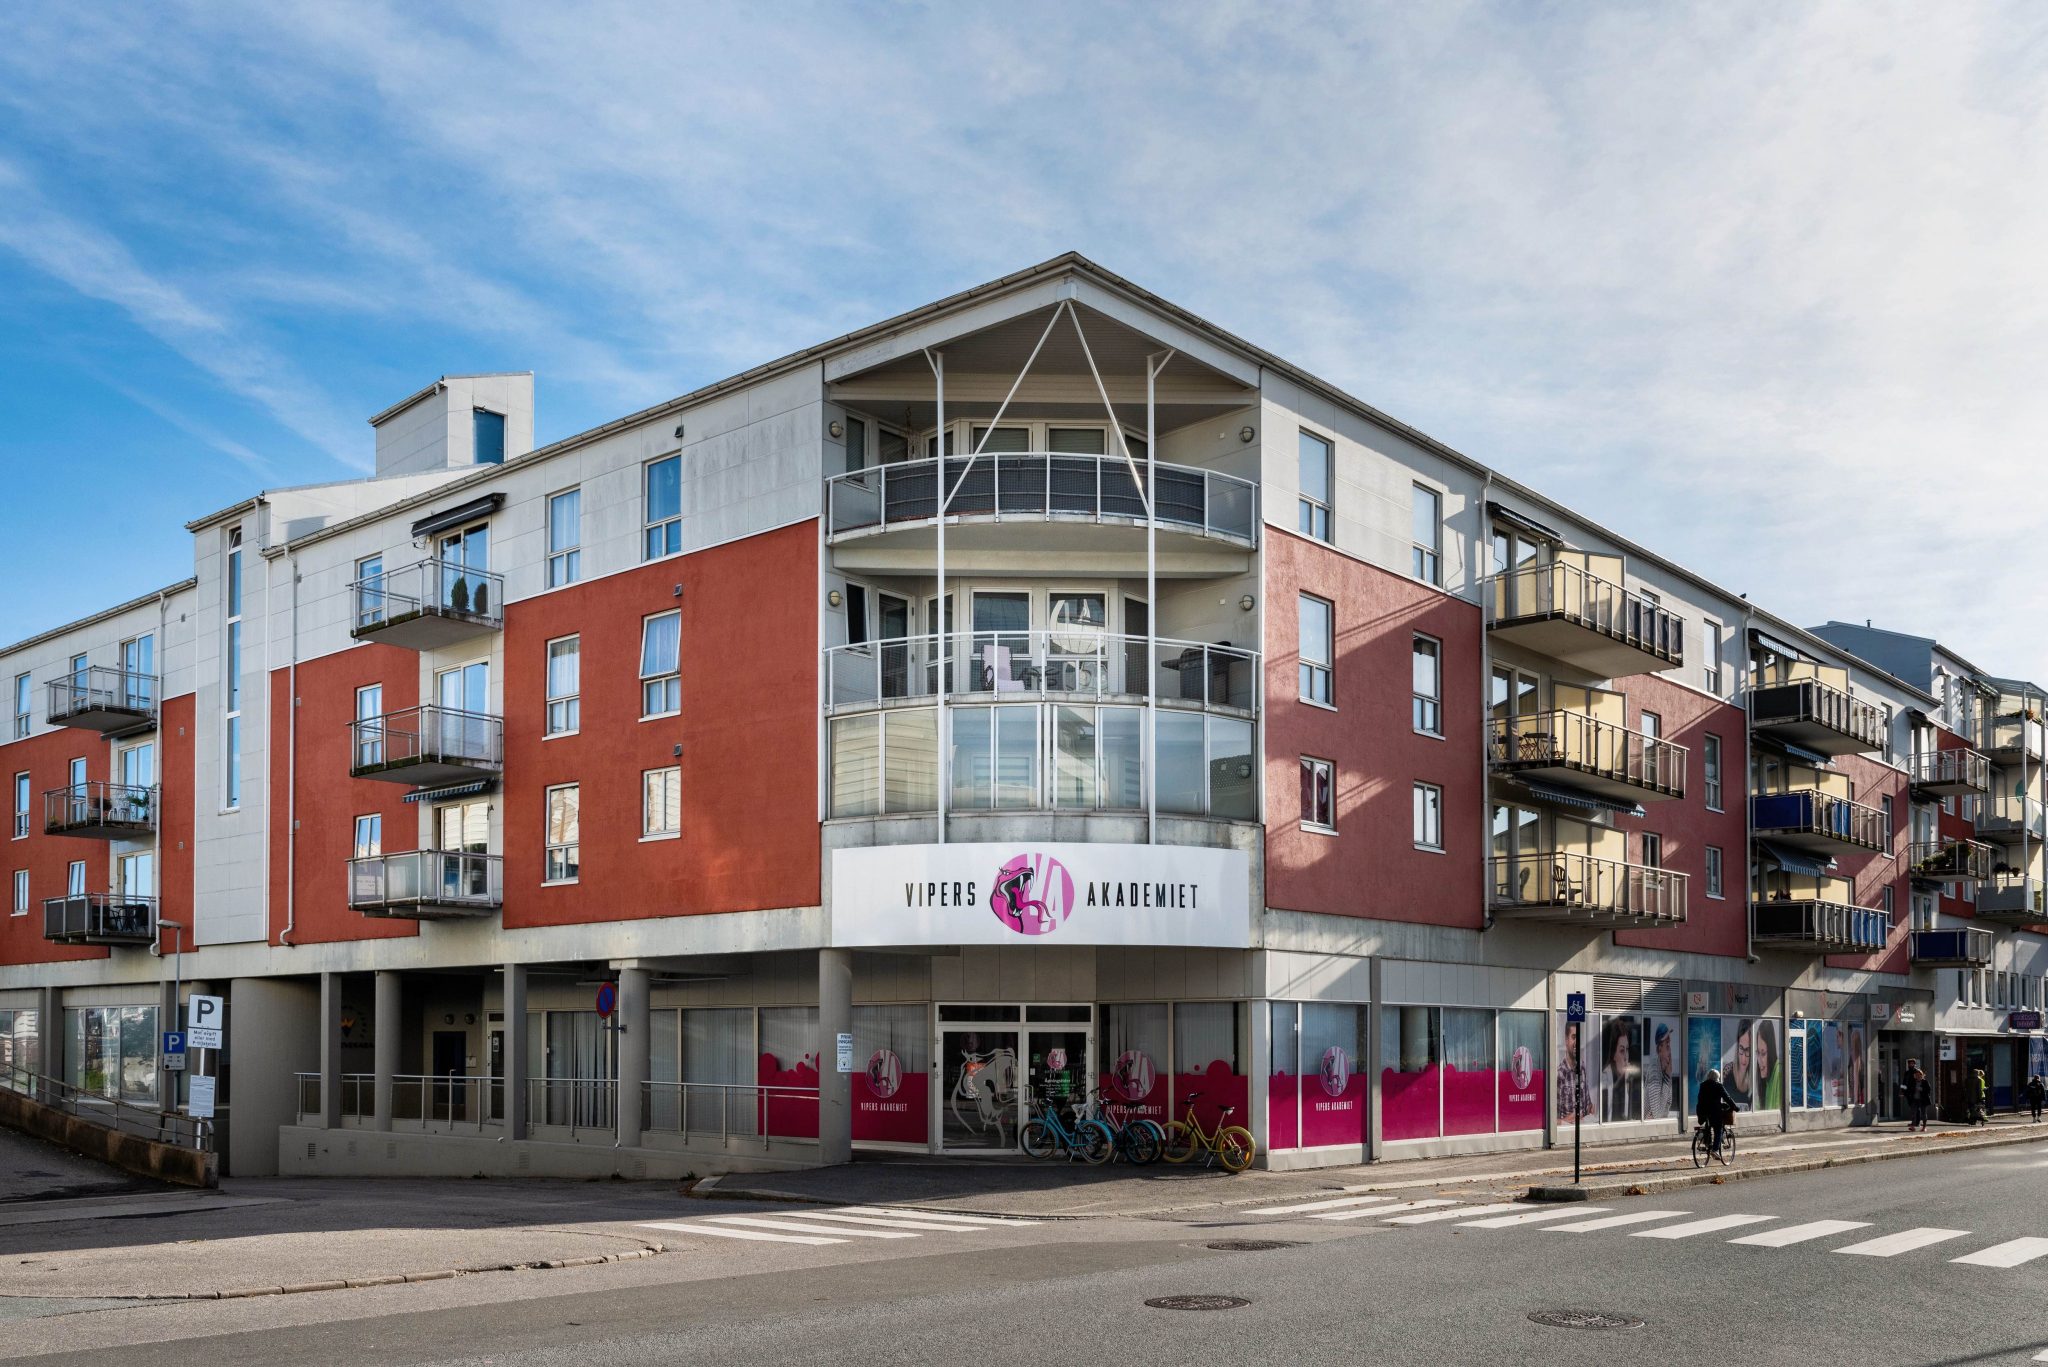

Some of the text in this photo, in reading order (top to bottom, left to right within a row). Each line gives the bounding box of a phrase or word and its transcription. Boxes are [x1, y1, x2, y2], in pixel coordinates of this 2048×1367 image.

[905, 881, 1199, 909] VIPERS AKADEMIET
[196, 999, 215, 1024] P
[168, 1034, 180, 1051] P
[860, 1102, 908, 1112] VIPERS AKADEMIET
[1107, 1104, 1127, 1114] IPERS
[1315, 1100, 1353, 1111] VIPERS AKADEMIET
